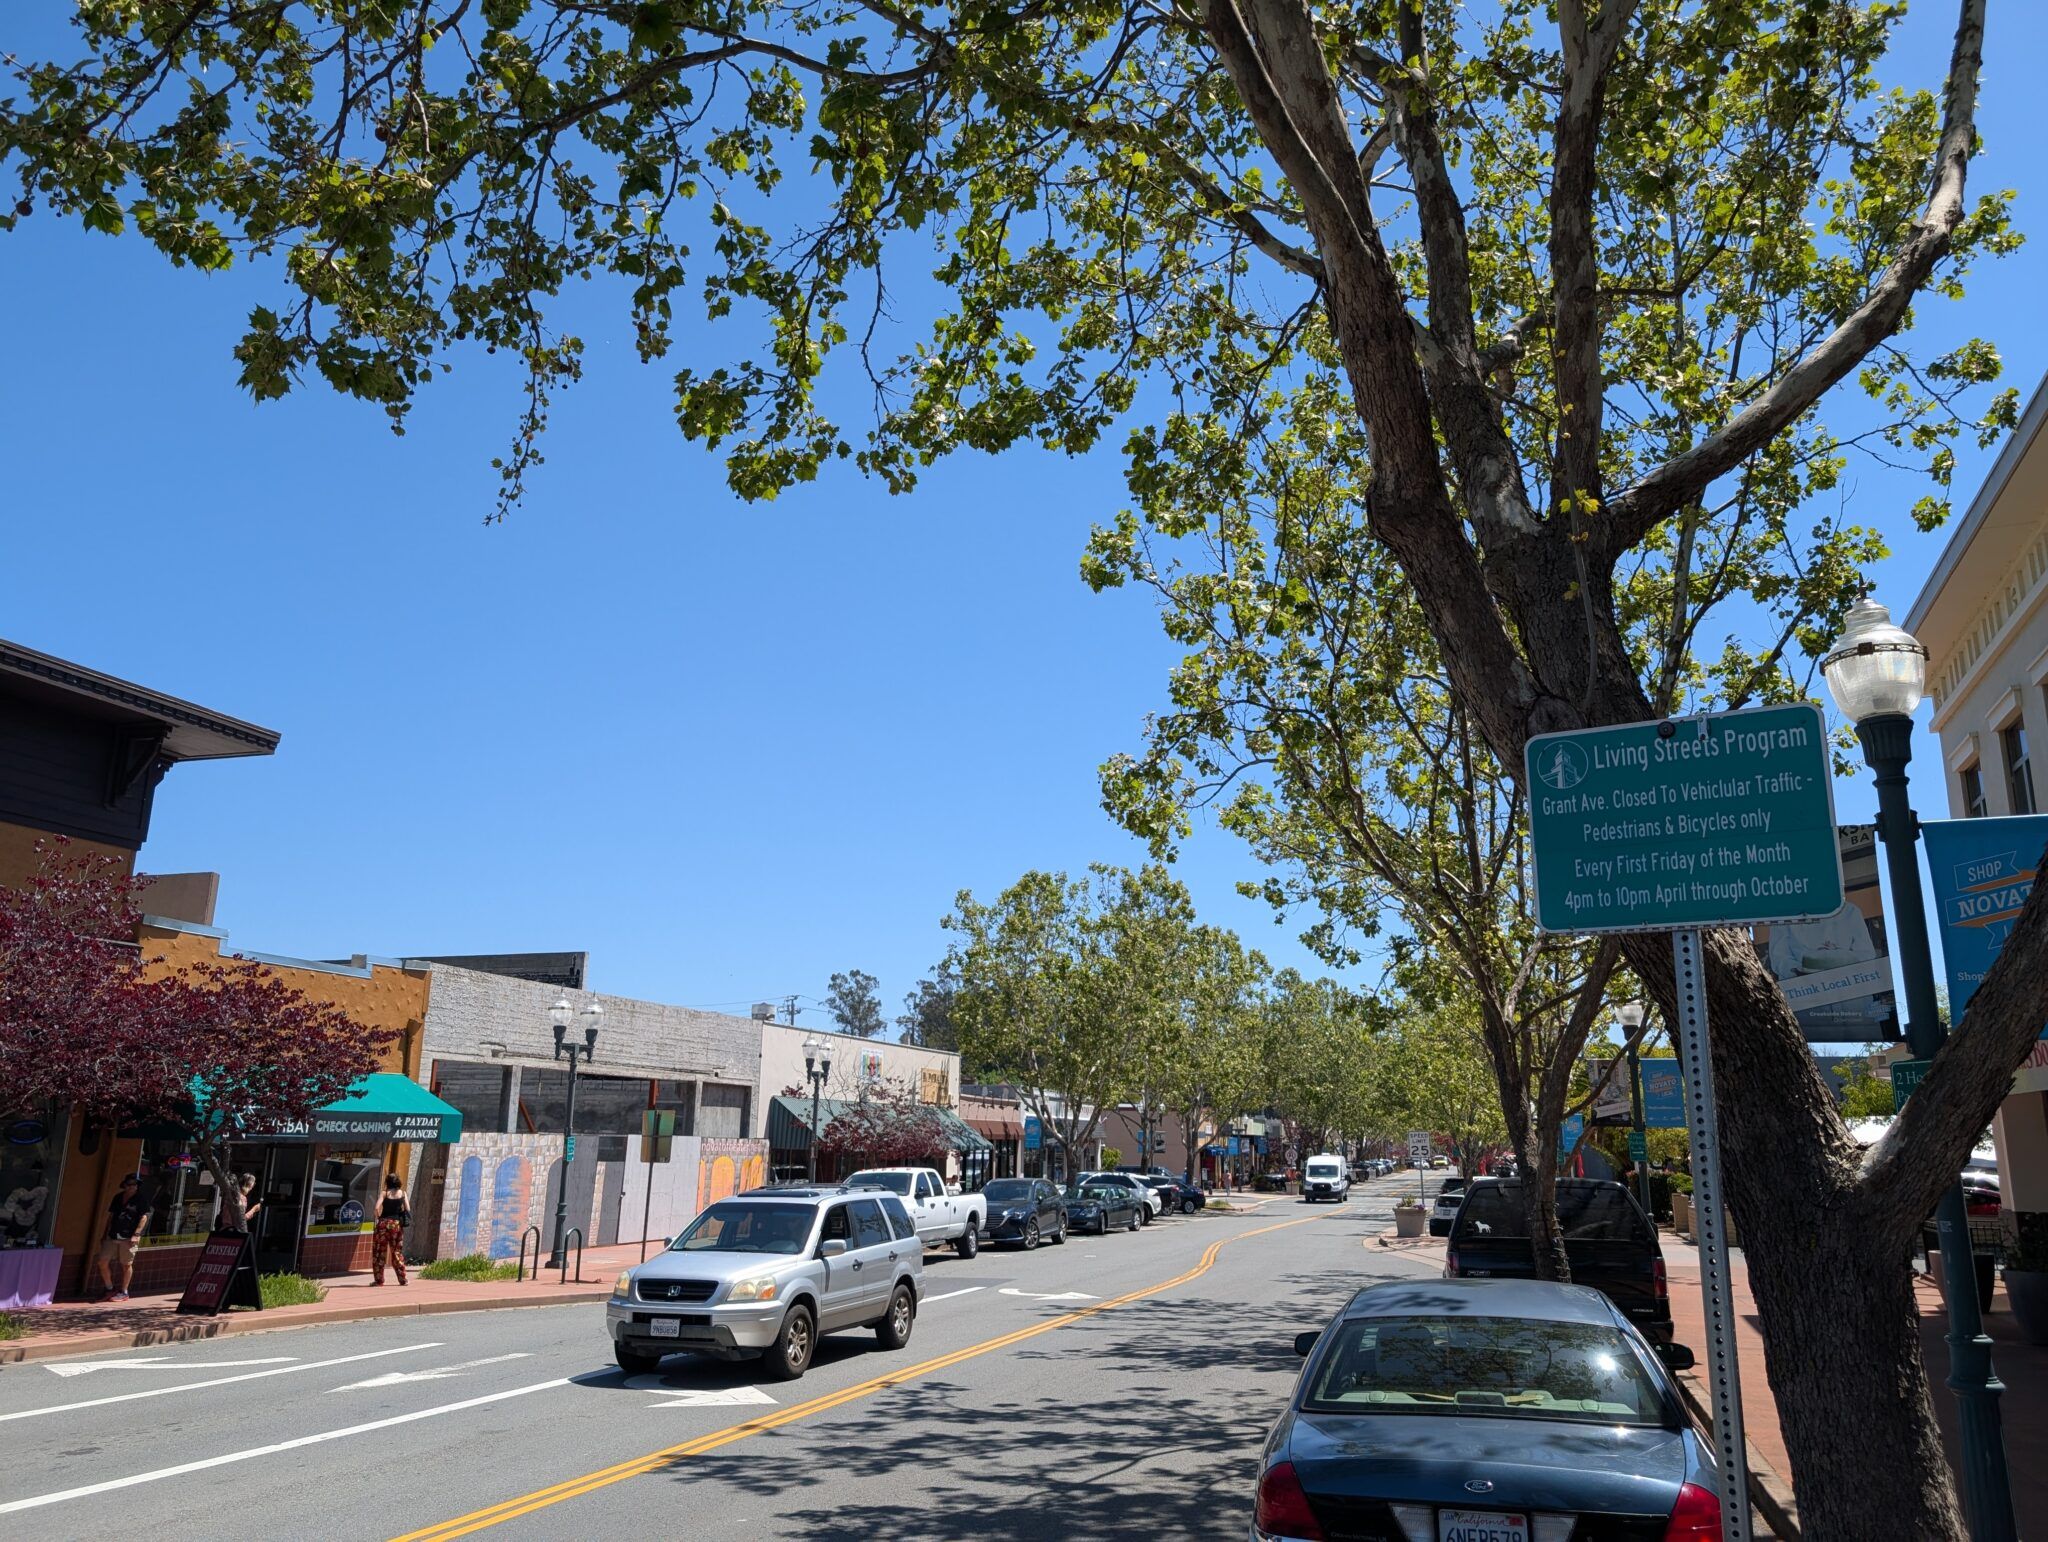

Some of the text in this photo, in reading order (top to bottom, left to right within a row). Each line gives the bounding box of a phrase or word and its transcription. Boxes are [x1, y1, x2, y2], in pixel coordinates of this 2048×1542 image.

[1594, 727, 1807, 771] Living Streets Program
[1543, 797, 1577, 815] Grant
[1581, 793, 1609, 811] Ave.
[1613, 786, 1657, 808] Closed
[1661, 785, 1677, 803] To
[1681, 778, 1751, 801] Vehiclular
[1755, 773, 1802, 795] Traffic
[1583, 808, 1772, 842] Pedestrians & Bicycles only
[1575, 842, 1791, 881] Every First Friday of the Month
[1968, 860, 2003, 883] SHOP
[1565, 875, 1809, 914] 4pm to 10pm April through October
[1958, 884, 2034, 918] NOVAT
[1786, 971, 1881, 1000] Think Local First
[1896, 1071, 1924, 1085] 2 Ho
[316, 1119, 348, 1133] CHECK
[350, 1121, 392, 1133] CASHING
[403, 1116, 441, 1127] PAYDAY
[393, 1128, 438, 1139] ADVANCES
[1411, 1145, 1429, 1156] 25
[205, 1245, 240, 1257] CRYSTALS
[198, 1263, 232, 1275] JEWELRY
[195, 1282, 218, 1294] GIFTS
[1457, 1511, 1510, 1528] California
